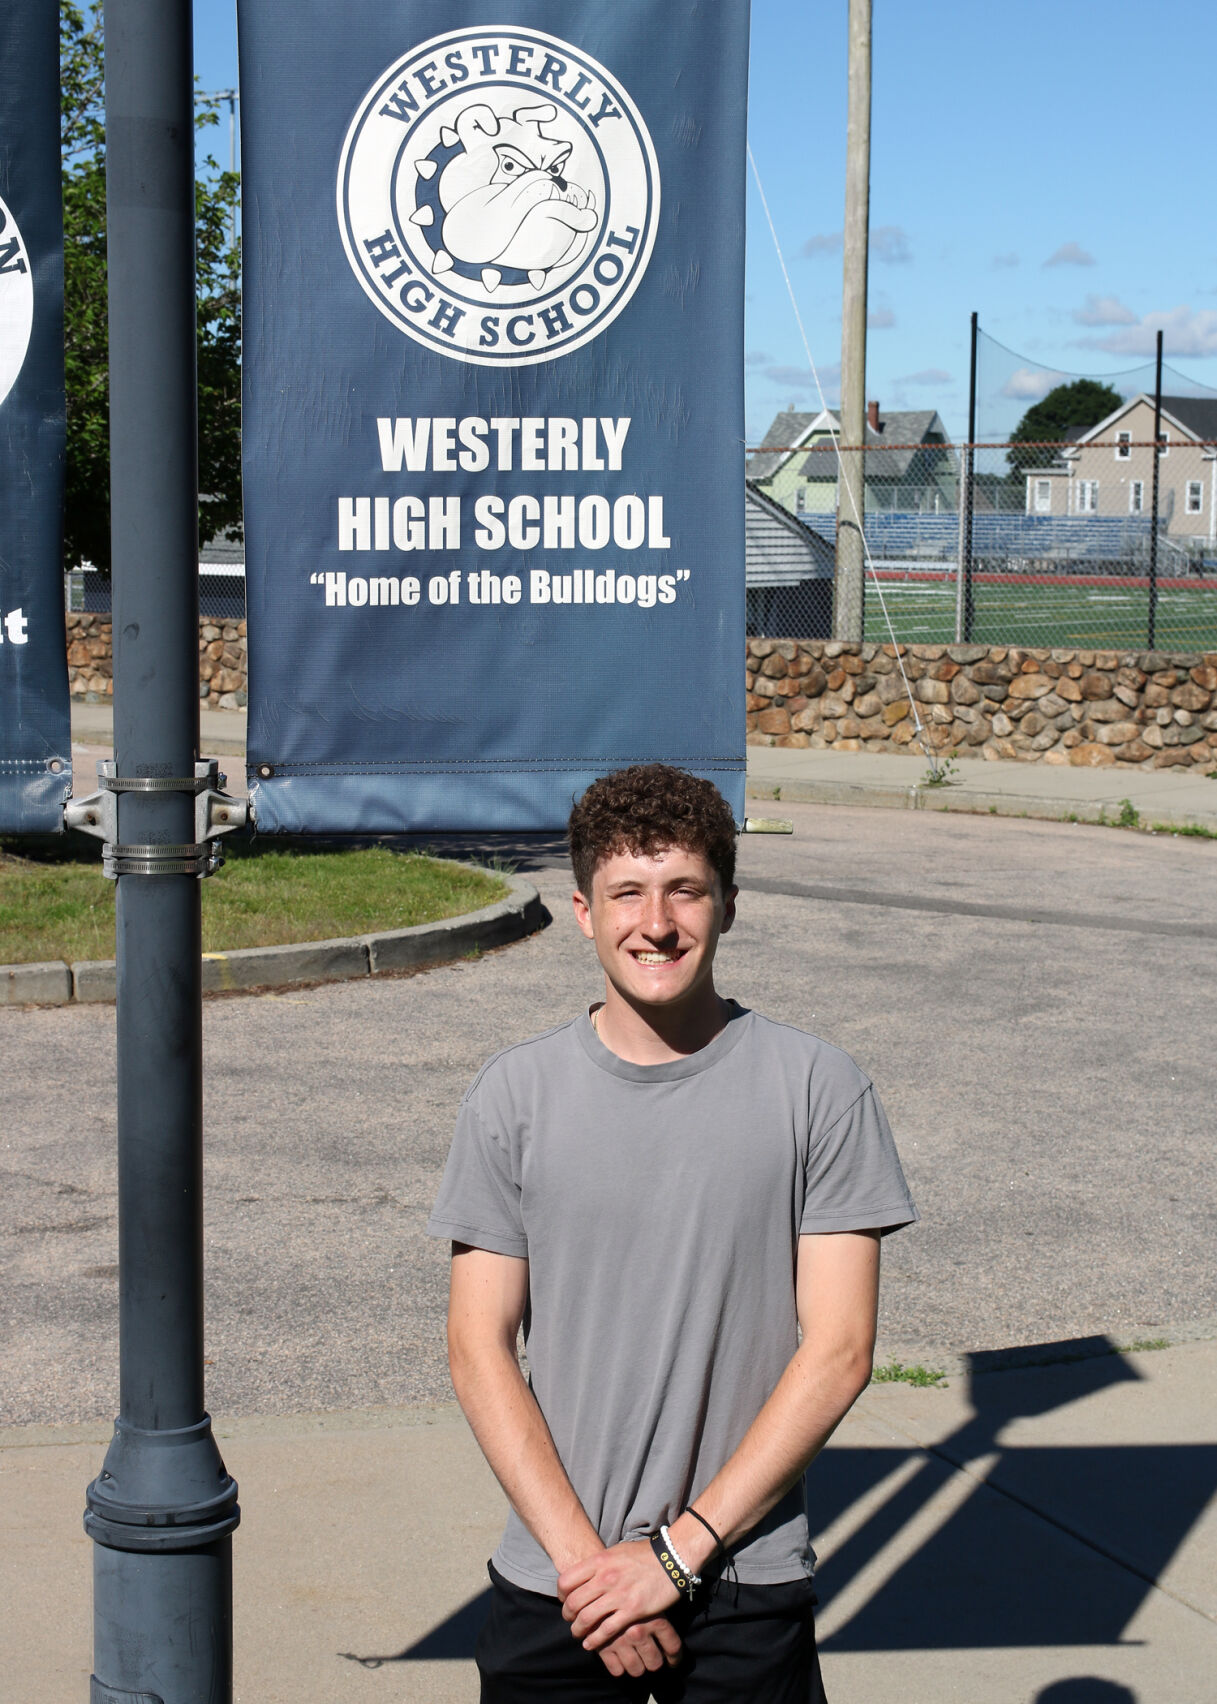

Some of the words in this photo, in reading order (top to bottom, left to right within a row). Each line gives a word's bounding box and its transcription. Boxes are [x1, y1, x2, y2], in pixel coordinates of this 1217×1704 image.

[378, 44, 622, 128] WESTERLY
[0, 207, 28, 274] N
[362, 229, 466, 338] HIGH
[479, 225, 640, 347] SCHOOL
[376, 416, 632, 472] WESTERLY
[338, 496, 461, 551] HIGH
[474, 495, 671, 550] SCHOOL
[310, 571, 421, 606] “Home
[428, 570, 462, 605] of
[467, 569, 522, 604] the
[530, 568, 691, 608] Bulldogs”
[0, 607, 28, 645] t
